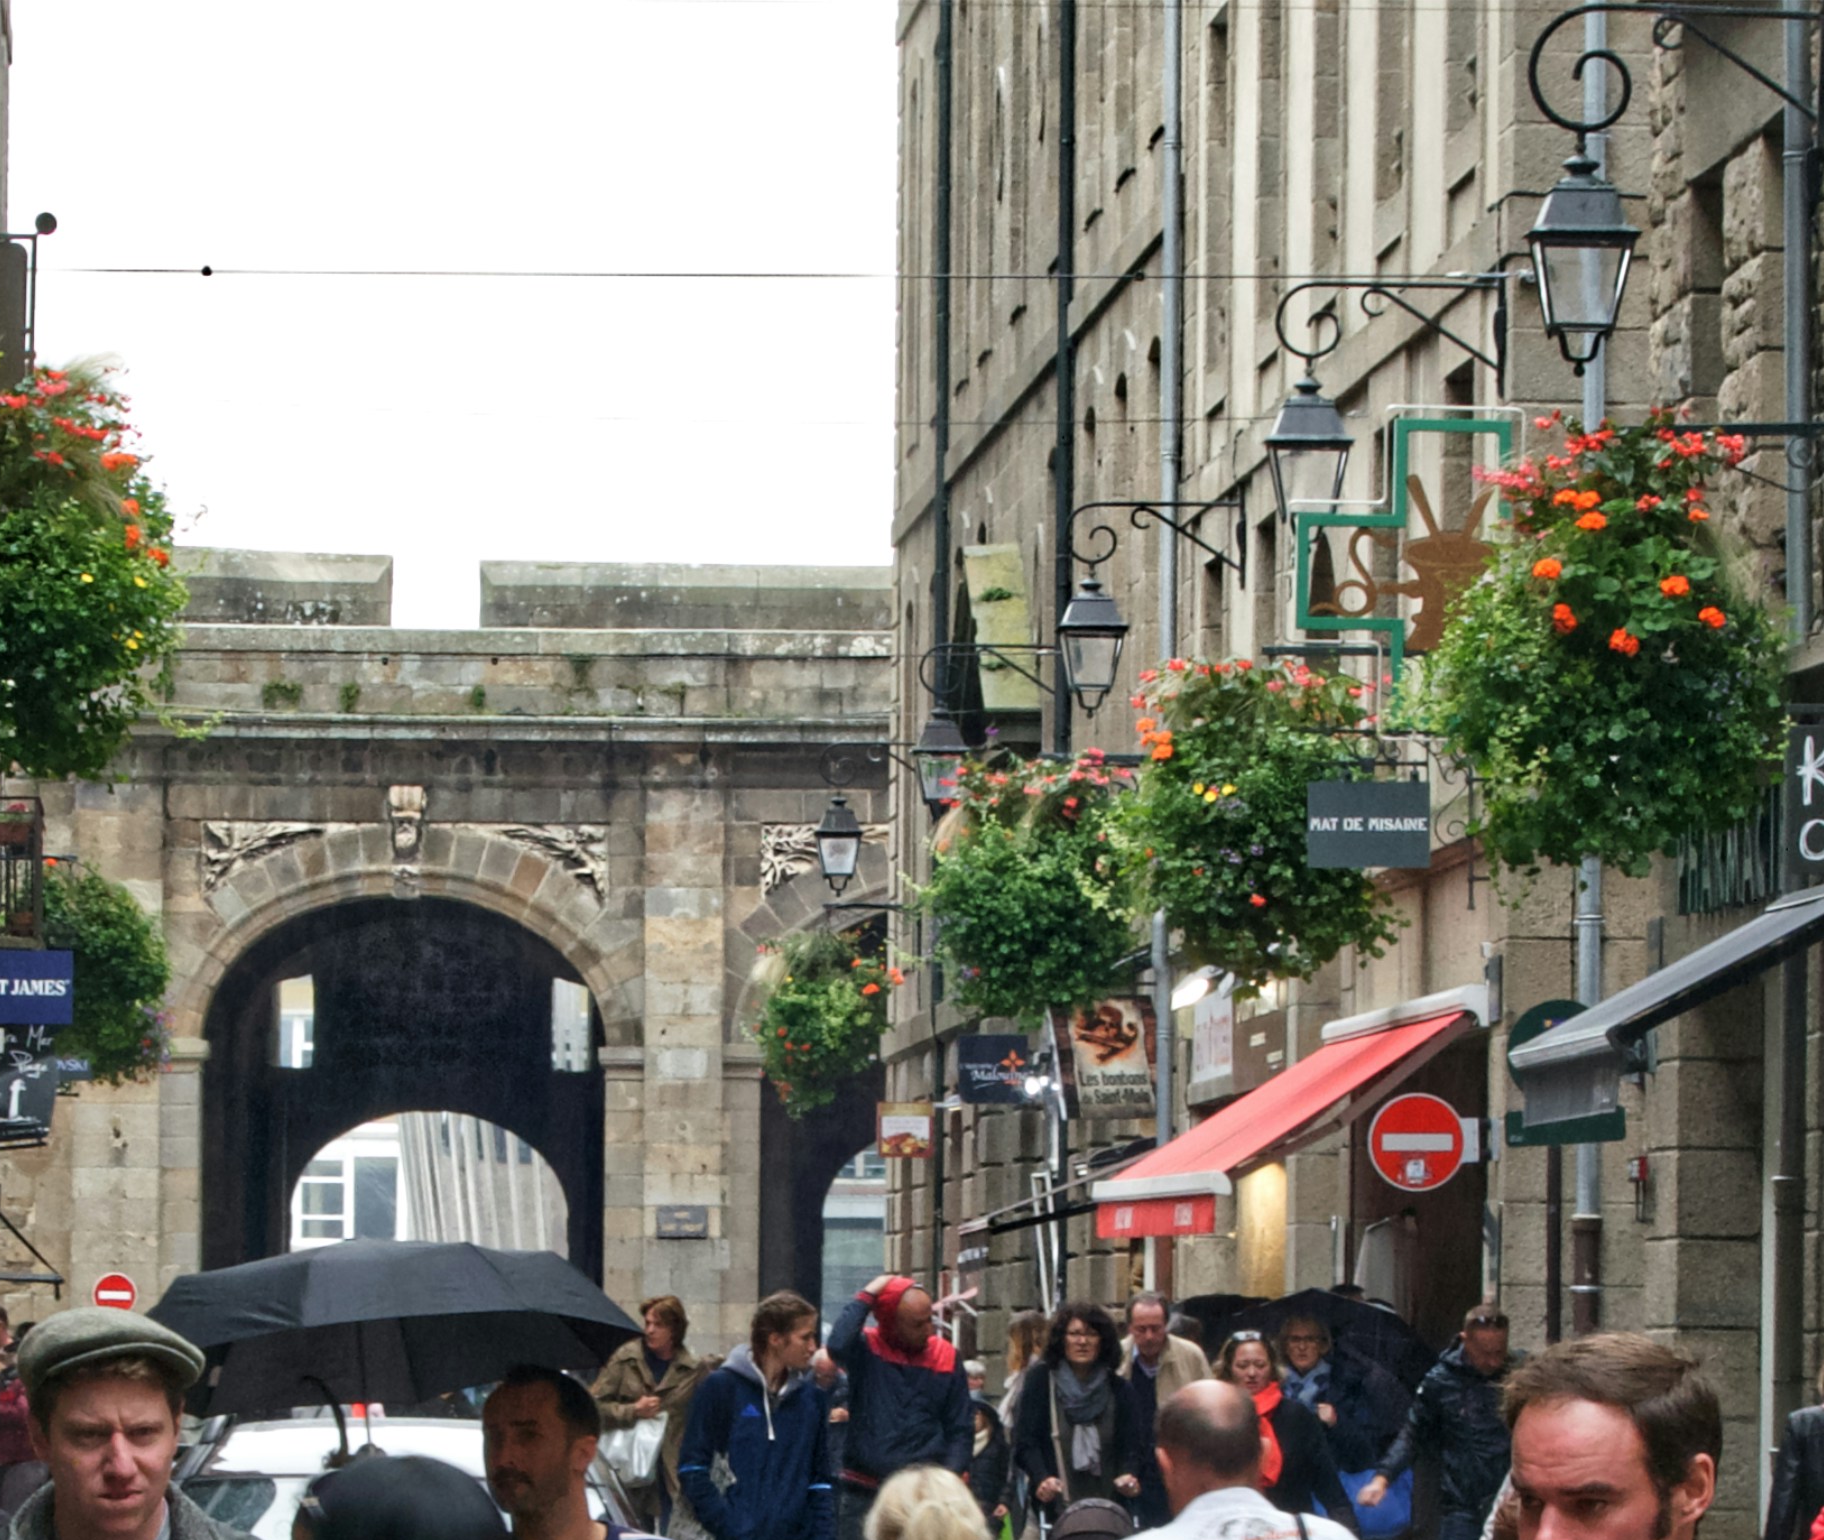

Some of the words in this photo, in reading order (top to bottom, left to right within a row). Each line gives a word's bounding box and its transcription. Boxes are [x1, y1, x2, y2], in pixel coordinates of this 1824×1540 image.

[1309, 817, 1338, 832] MAT
[1343, 817, 1364, 832] DE
[1368, 817, 1428, 832] MISAINE
[10, 979, 67, 997] JAMES
[1078, 1069, 1100, 1087] Les
